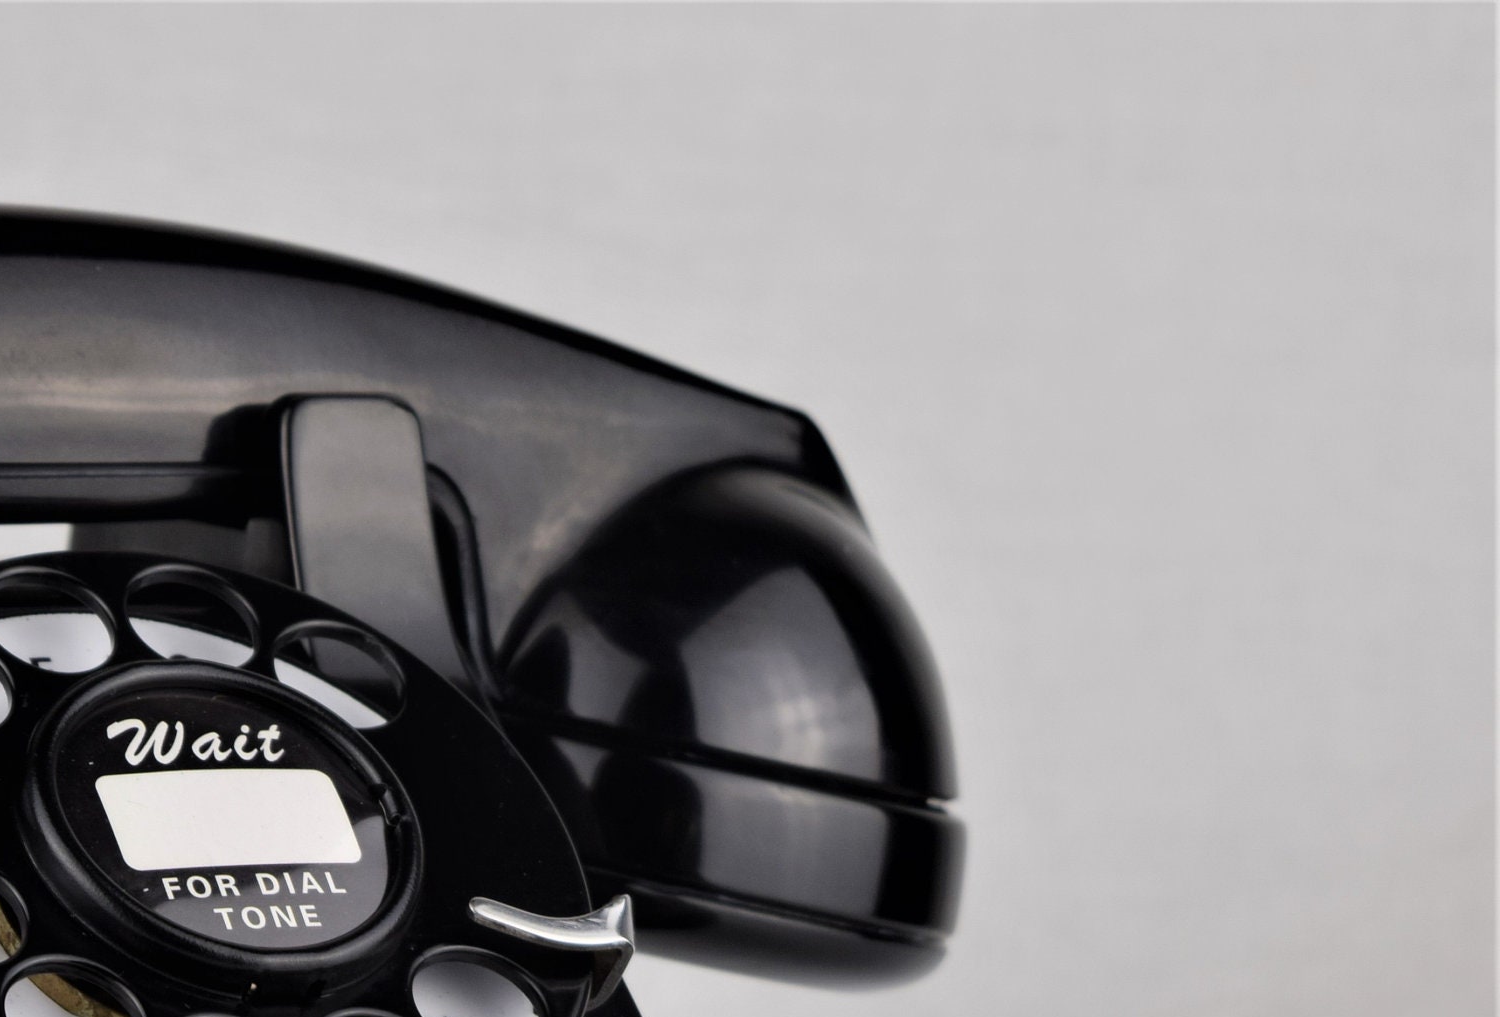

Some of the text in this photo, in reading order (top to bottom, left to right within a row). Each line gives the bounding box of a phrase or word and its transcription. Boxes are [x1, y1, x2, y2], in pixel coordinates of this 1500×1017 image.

[106, 718, 285, 766] Wait
[161, 871, 347, 900] FOR DIAL
[213, 904, 323, 931] TONE
